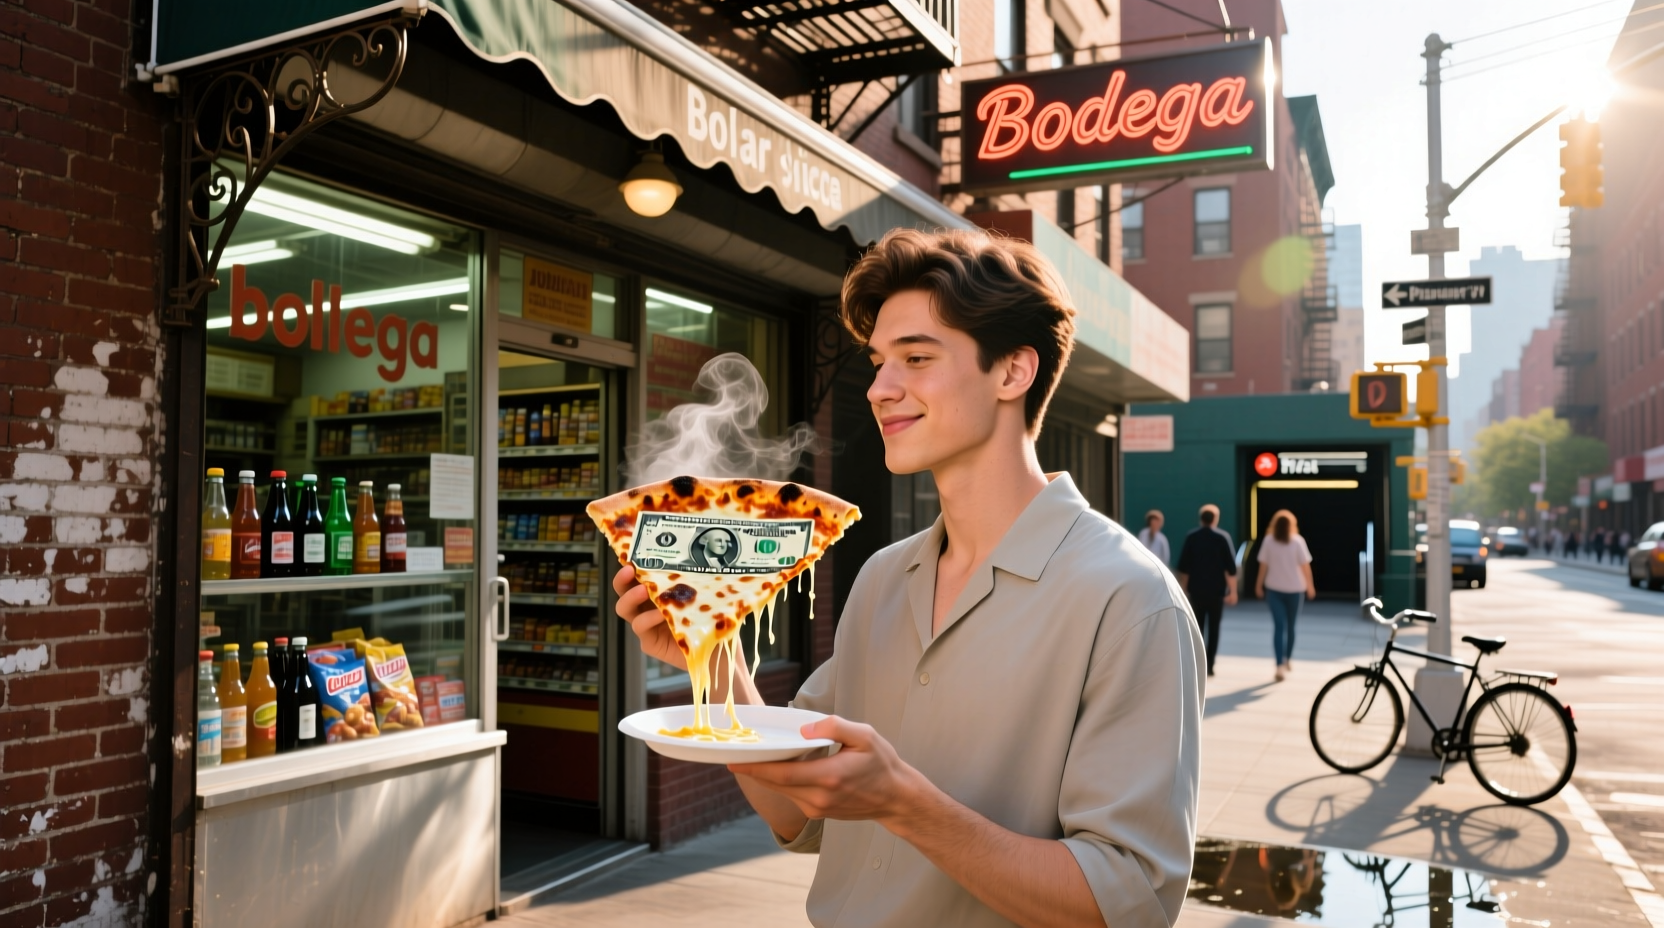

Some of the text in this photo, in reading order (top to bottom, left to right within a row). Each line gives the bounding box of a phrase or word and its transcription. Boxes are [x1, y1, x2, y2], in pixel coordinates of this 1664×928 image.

[687, 83, 772, 173] Bolar
[977, 70, 1253, 159] Bodega
[229, 264, 438, 382] bollega
